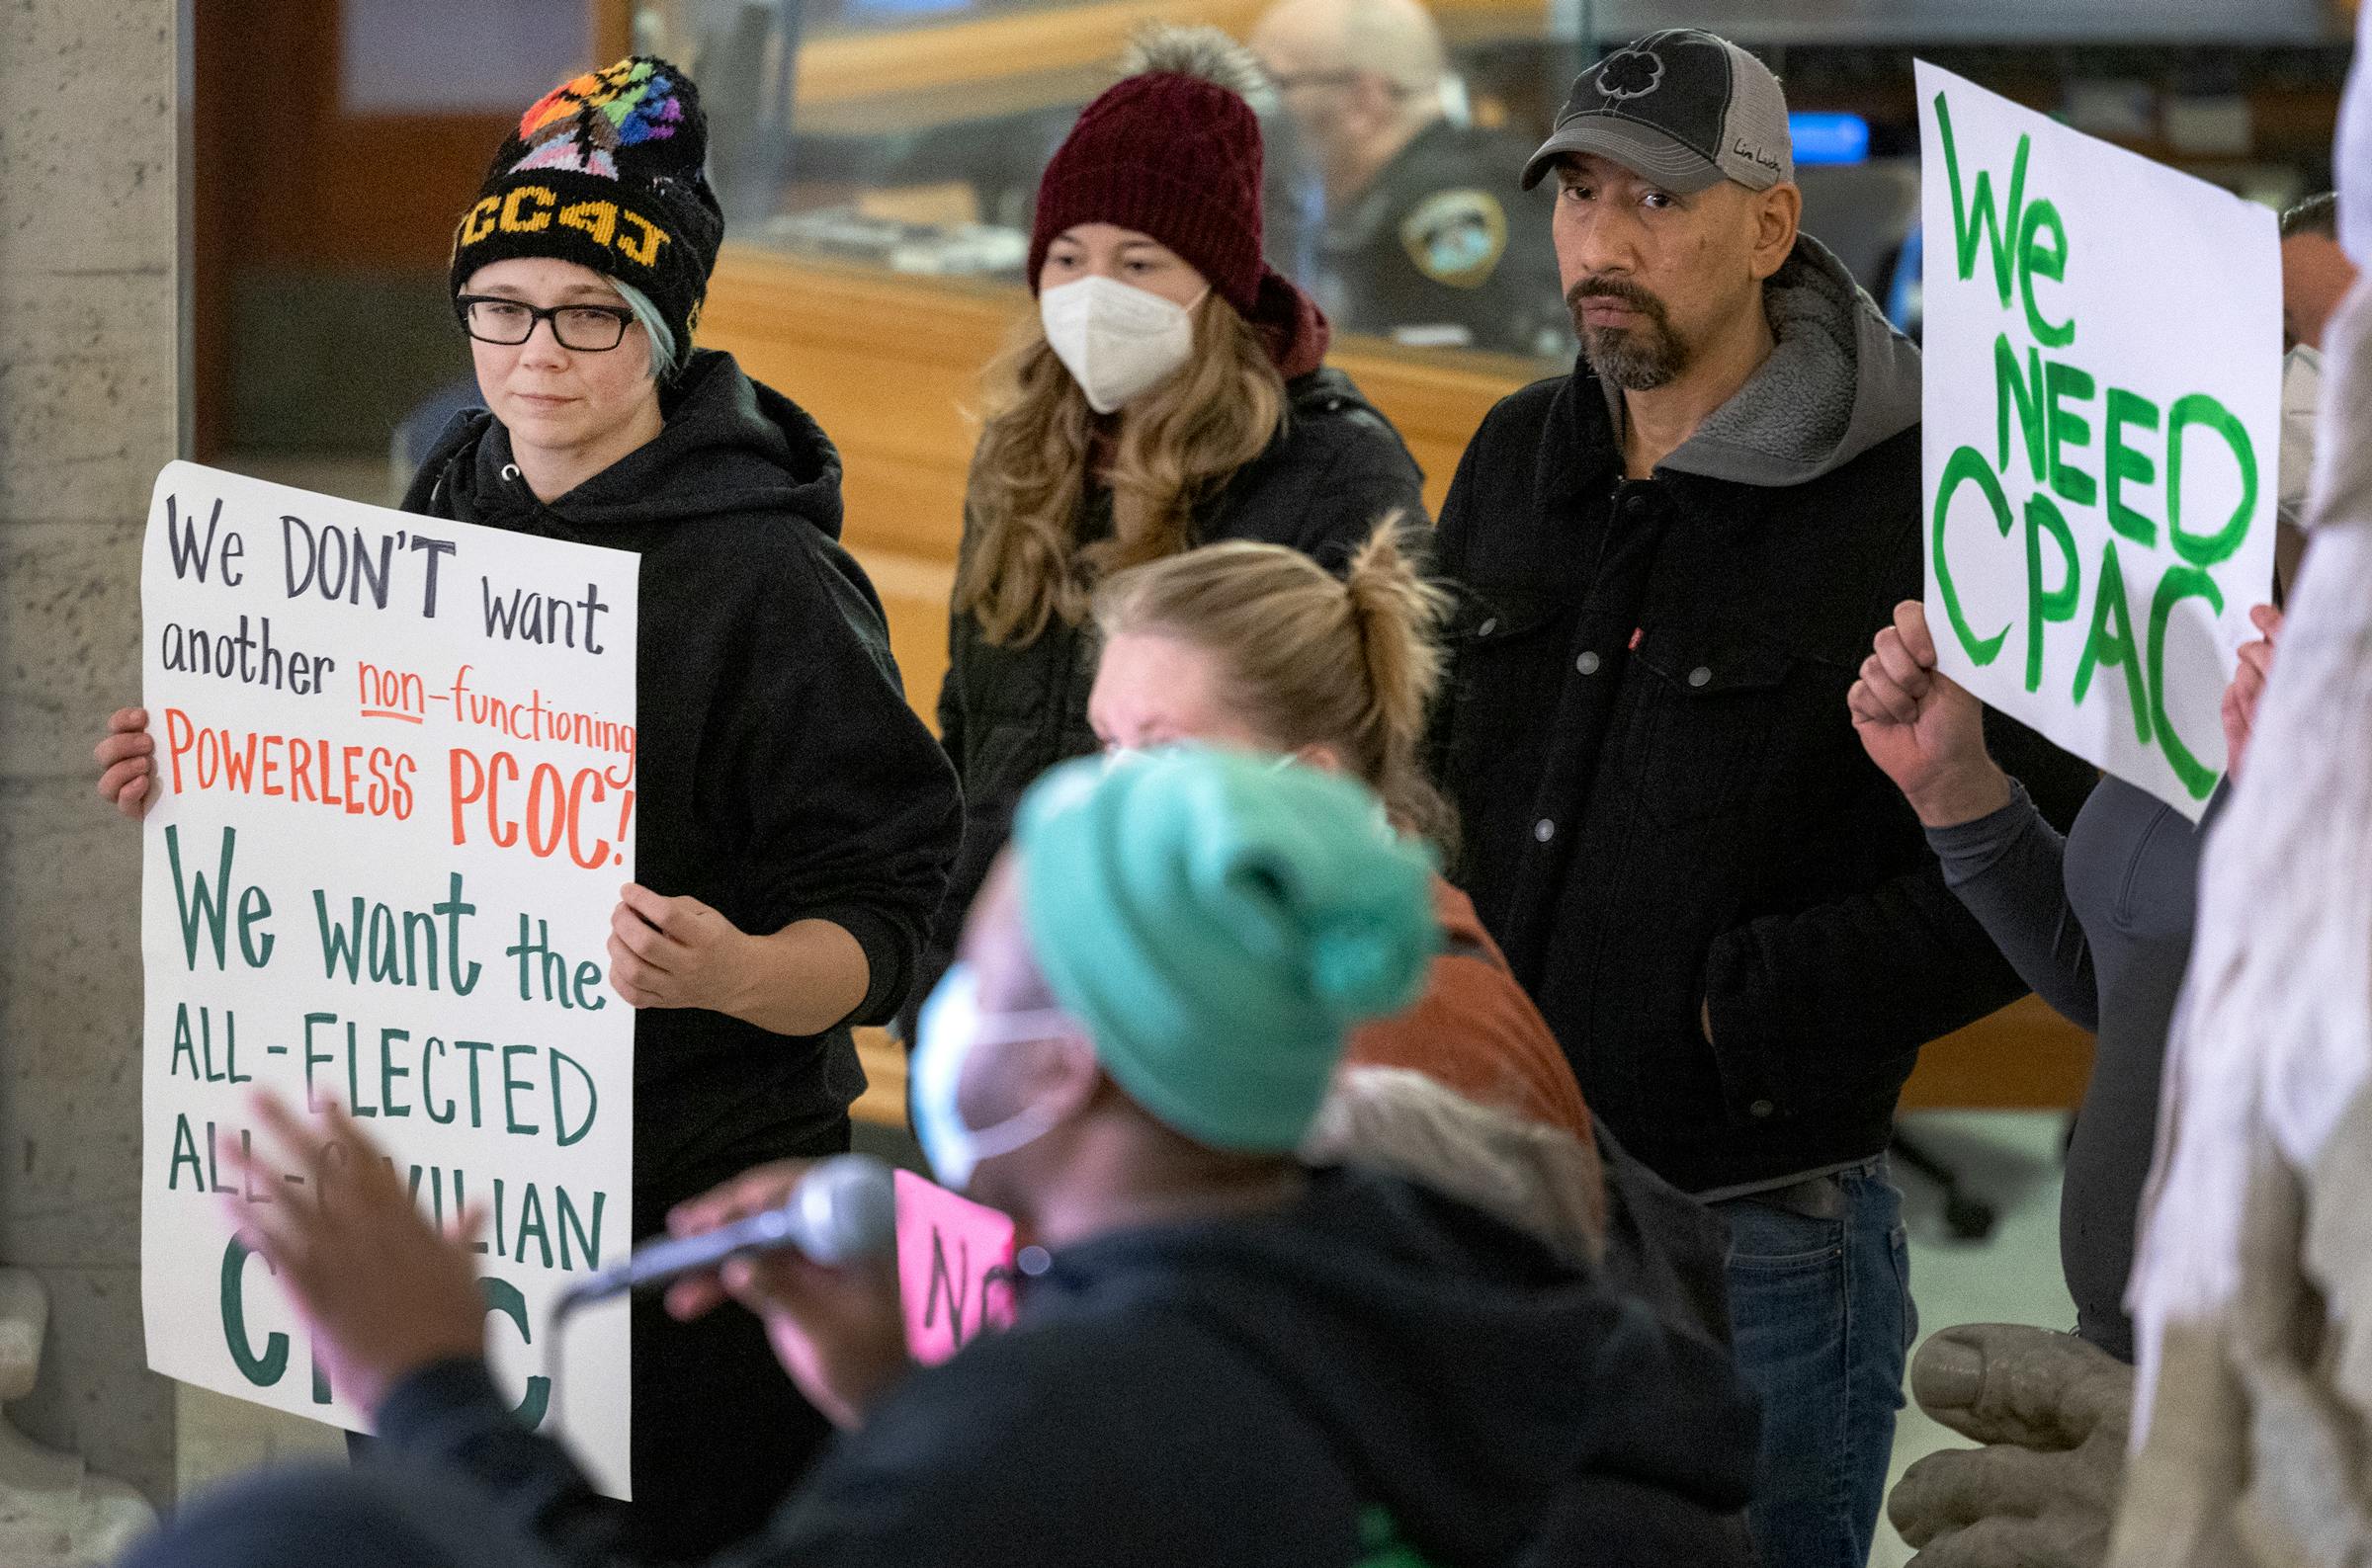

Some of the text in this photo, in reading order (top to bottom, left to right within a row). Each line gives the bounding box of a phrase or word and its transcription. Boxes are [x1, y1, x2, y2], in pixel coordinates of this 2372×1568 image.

[1933, 90, 2075, 348] We
[1993, 331, 2258, 567] NEED
[166, 493, 610, 655] We DON'T want
[1932, 445, 2225, 800] CPAC
[161, 615, 635, 789] another non-functioning
[164, 707, 635, 869] POWERLESS PCOC!
[165, 824, 608, 1010] We want the
